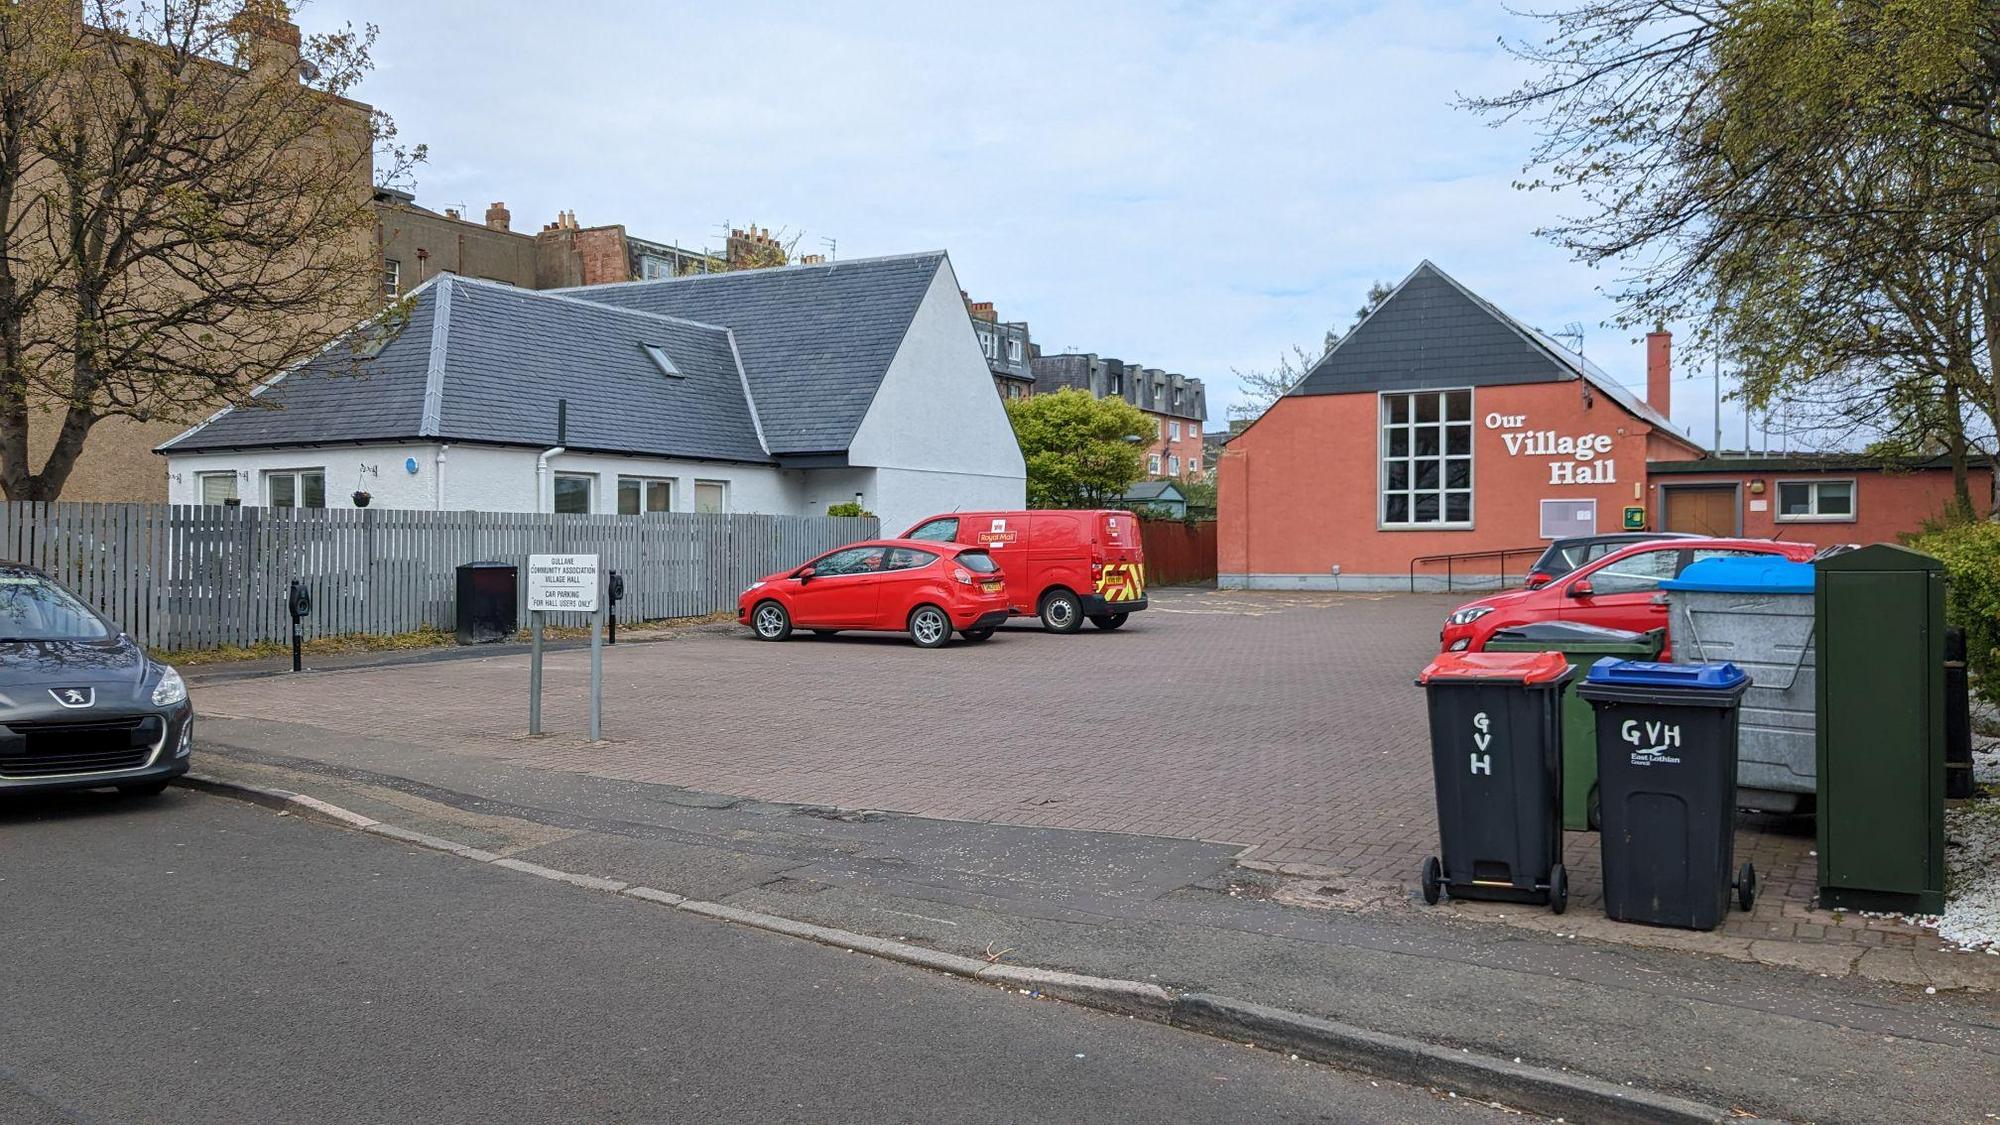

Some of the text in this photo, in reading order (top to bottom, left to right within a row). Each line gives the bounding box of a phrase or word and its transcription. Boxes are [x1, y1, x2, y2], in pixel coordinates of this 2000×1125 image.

[1485, 413, 1525, 429] Our
[1501, 430, 1613, 460] Village
[1548, 459, 1616, 484] Hall
[980, 533, 1015, 542] Royal Mail
[557, 591, 580, 599] PARKING
[1631, 753, 1680, 764] East Lothian
